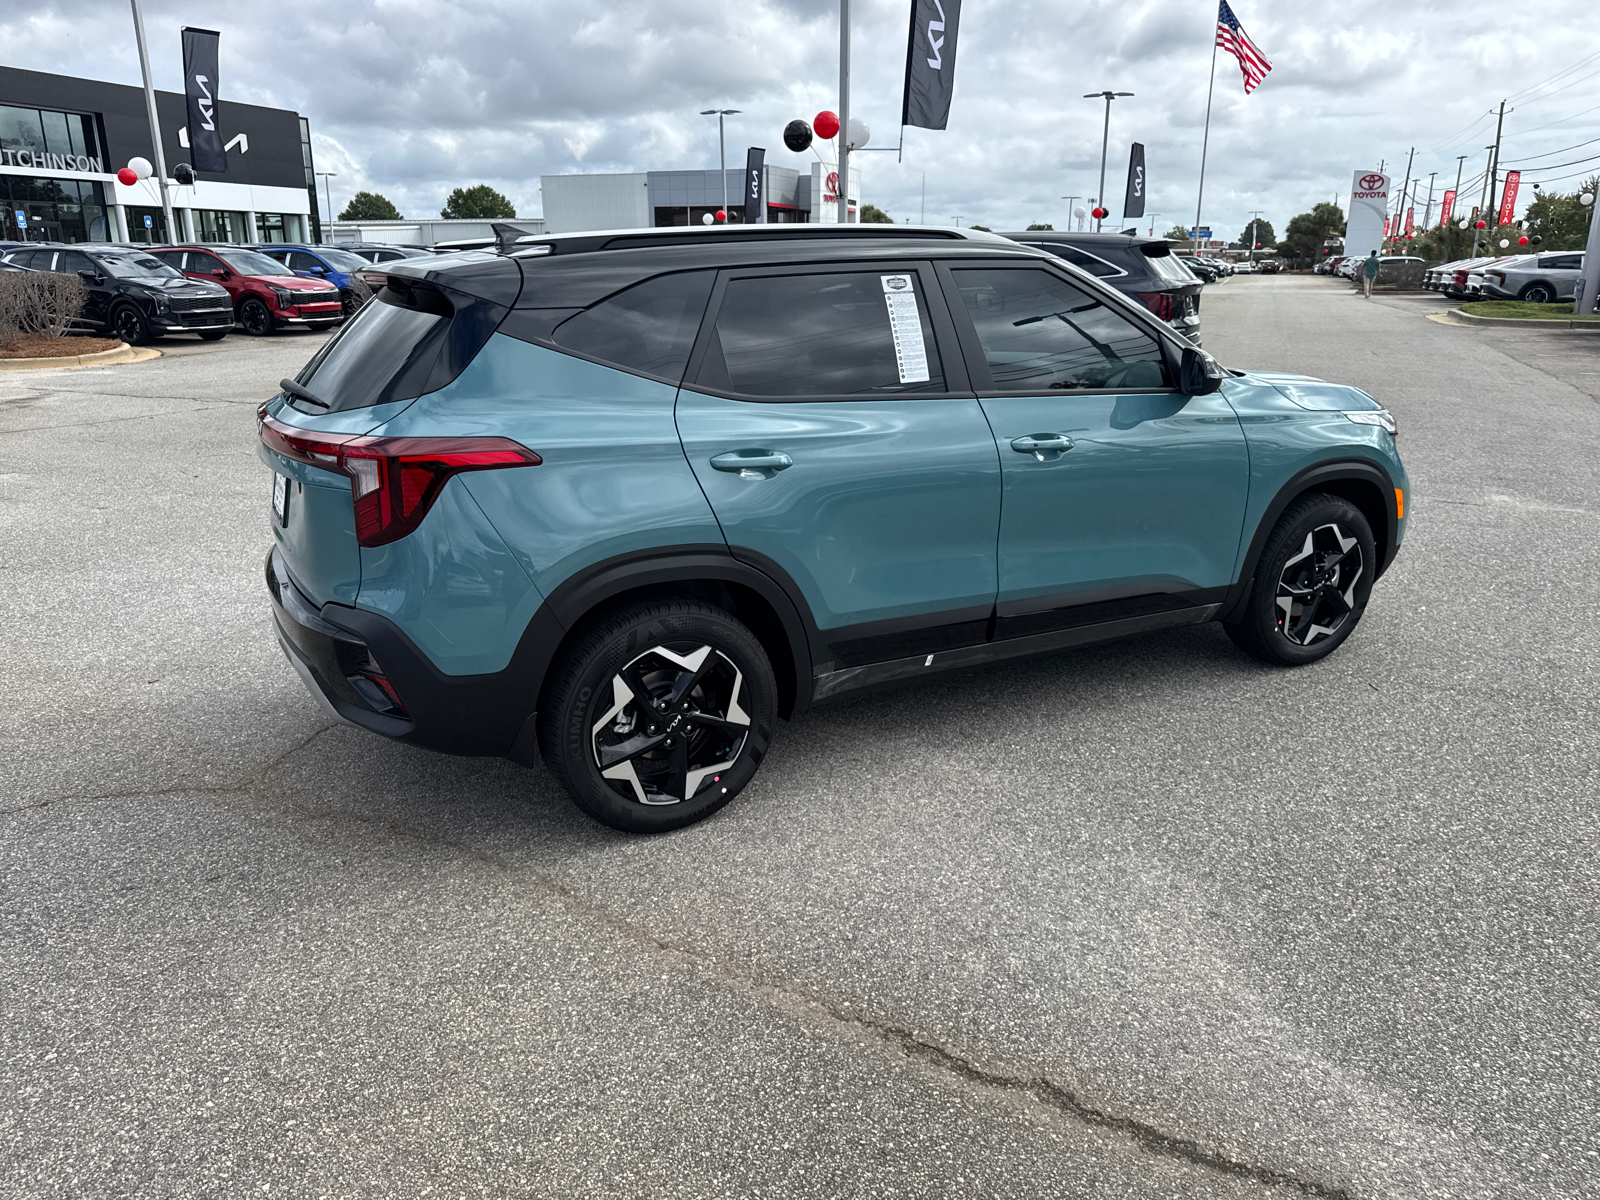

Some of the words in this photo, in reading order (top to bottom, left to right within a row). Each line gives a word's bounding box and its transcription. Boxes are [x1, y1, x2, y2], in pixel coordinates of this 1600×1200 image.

[195, 74, 215, 131] KIA
[751, 170, 759, 198] KIA
[1133, 166, 1143, 197] KIA
[1353, 191, 1387, 199] TOYOTA
[1502, 183, 1515, 223] TOYOTA
[569, 685, 593, 763] KUMHO
[666, 714, 682, 732] KIA
